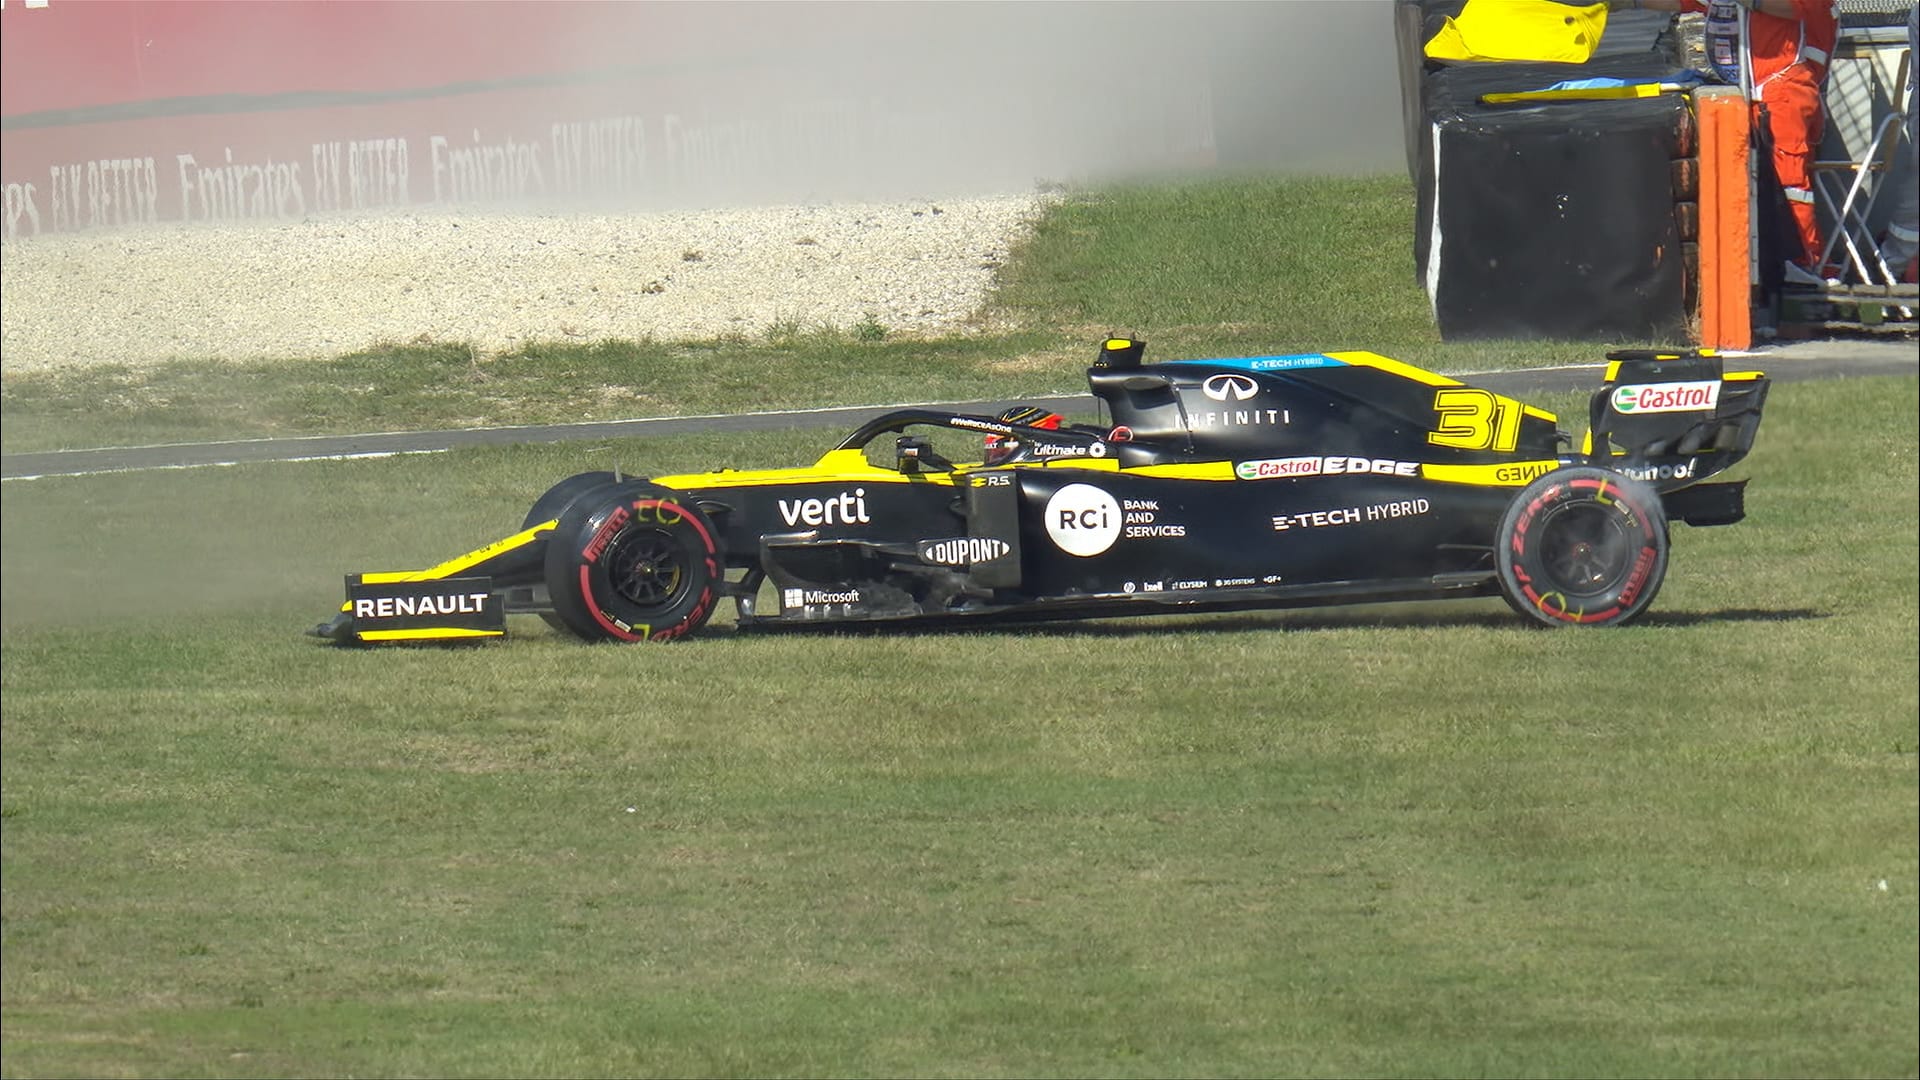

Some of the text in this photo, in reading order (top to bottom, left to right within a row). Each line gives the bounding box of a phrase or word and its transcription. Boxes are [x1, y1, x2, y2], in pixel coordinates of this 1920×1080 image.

[176, 146, 305, 224] Emirates
[1251, 357, 1324, 369] E-TECH HYBRID
[1639, 384, 1713, 409] Castrol
[950, 417, 1012, 433] #WeRaceAsOne
[1174, 409, 1291, 432] INFINITI
[1427, 388, 1524, 453] 31
[1033, 445, 1086, 456] ultimate
[1258, 456, 1421, 478] Castrol EDGE
[777, 487, 871, 527] verti
[1123, 499, 1160, 512] BANK
[1272, 498, 1430, 531] E-TECH HYBRID
[1125, 512, 1155, 525] AND
[1125, 524, 1186, 539] SERVICES
[934, 537, 1001, 566] DUPONT
[355, 593, 489, 619] RENAULT
[804, 588, 860, 604] Microsoft
